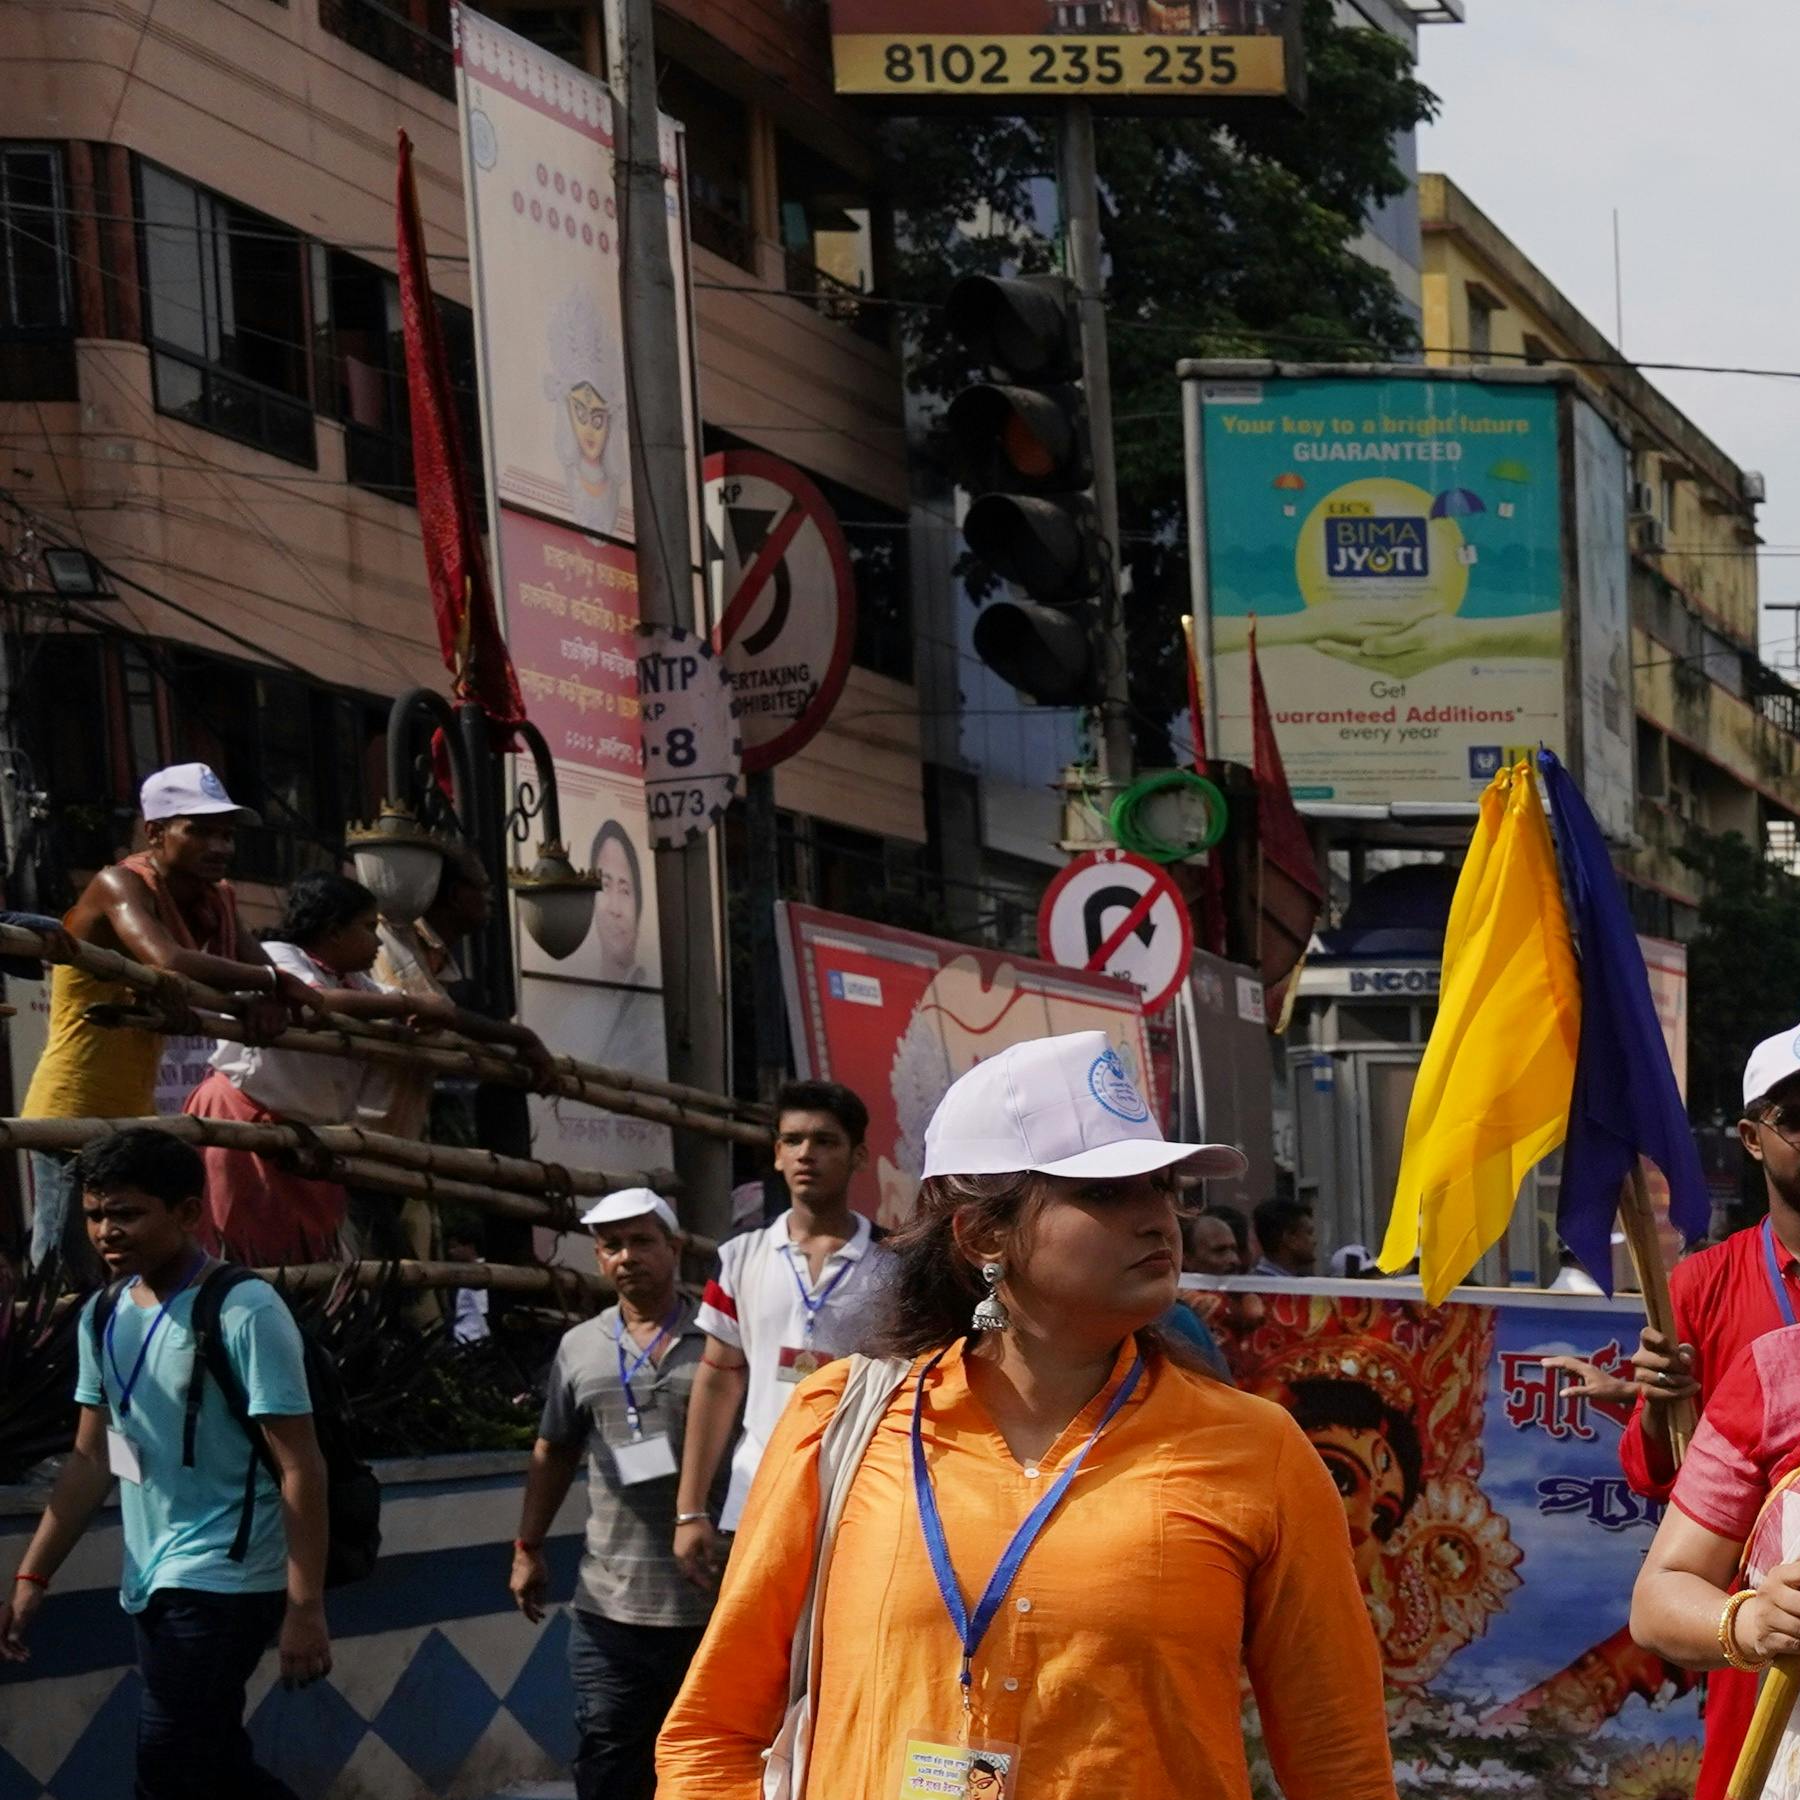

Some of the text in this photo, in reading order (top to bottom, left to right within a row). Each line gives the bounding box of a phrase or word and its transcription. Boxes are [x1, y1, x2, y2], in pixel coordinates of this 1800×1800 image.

[884, 42, 1238, 86] 8102 235 235
[1222, 415, 1530, 438] Your key to a bright future
[1292, 441, 1464, 462] GUARANTEED
[717, 484, 743, 505] KP
[1336, 522, 1421, 546] BIMA
[1332, 546, 1423, 573] JYOTI
[637, 652, 699, 694] NTP
[730, 663, 810, 692] ERTAKING
[1370, 681, 1407, 698] Get
[1268, 706, 1396, 725] uaranteed
[1338, 725, 1441, 743] every year
[1094, 847, 1127, 864] KP
